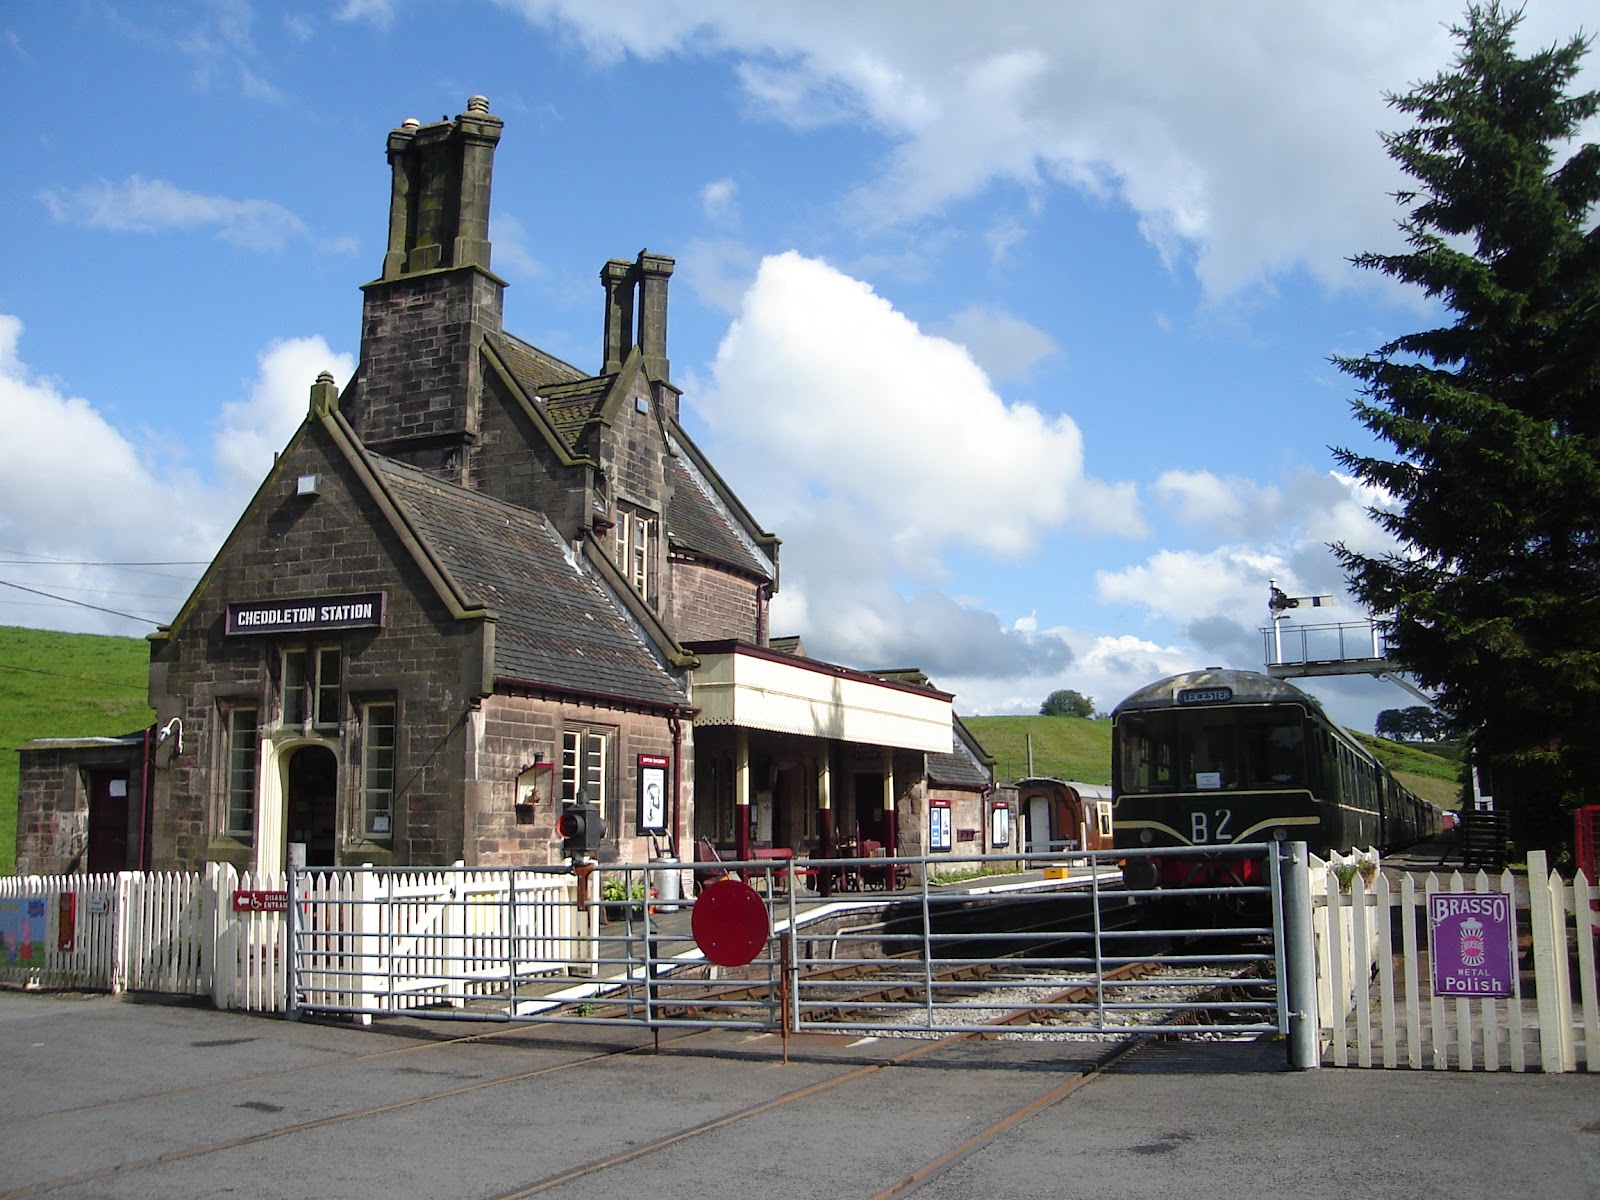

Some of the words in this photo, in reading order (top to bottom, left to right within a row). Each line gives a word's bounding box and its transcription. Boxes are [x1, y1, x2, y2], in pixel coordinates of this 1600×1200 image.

[237, 607, 316, 626] CHEDDLETON
[320, 603, 373, 621] STATION
[1183, 690, 1230, 703] LEICESTER
[1435, 898, 1505, 923] BRASSO
[1458, 968, 1491, 977] METAL
[1445, 976, 1502, 992] Polish
